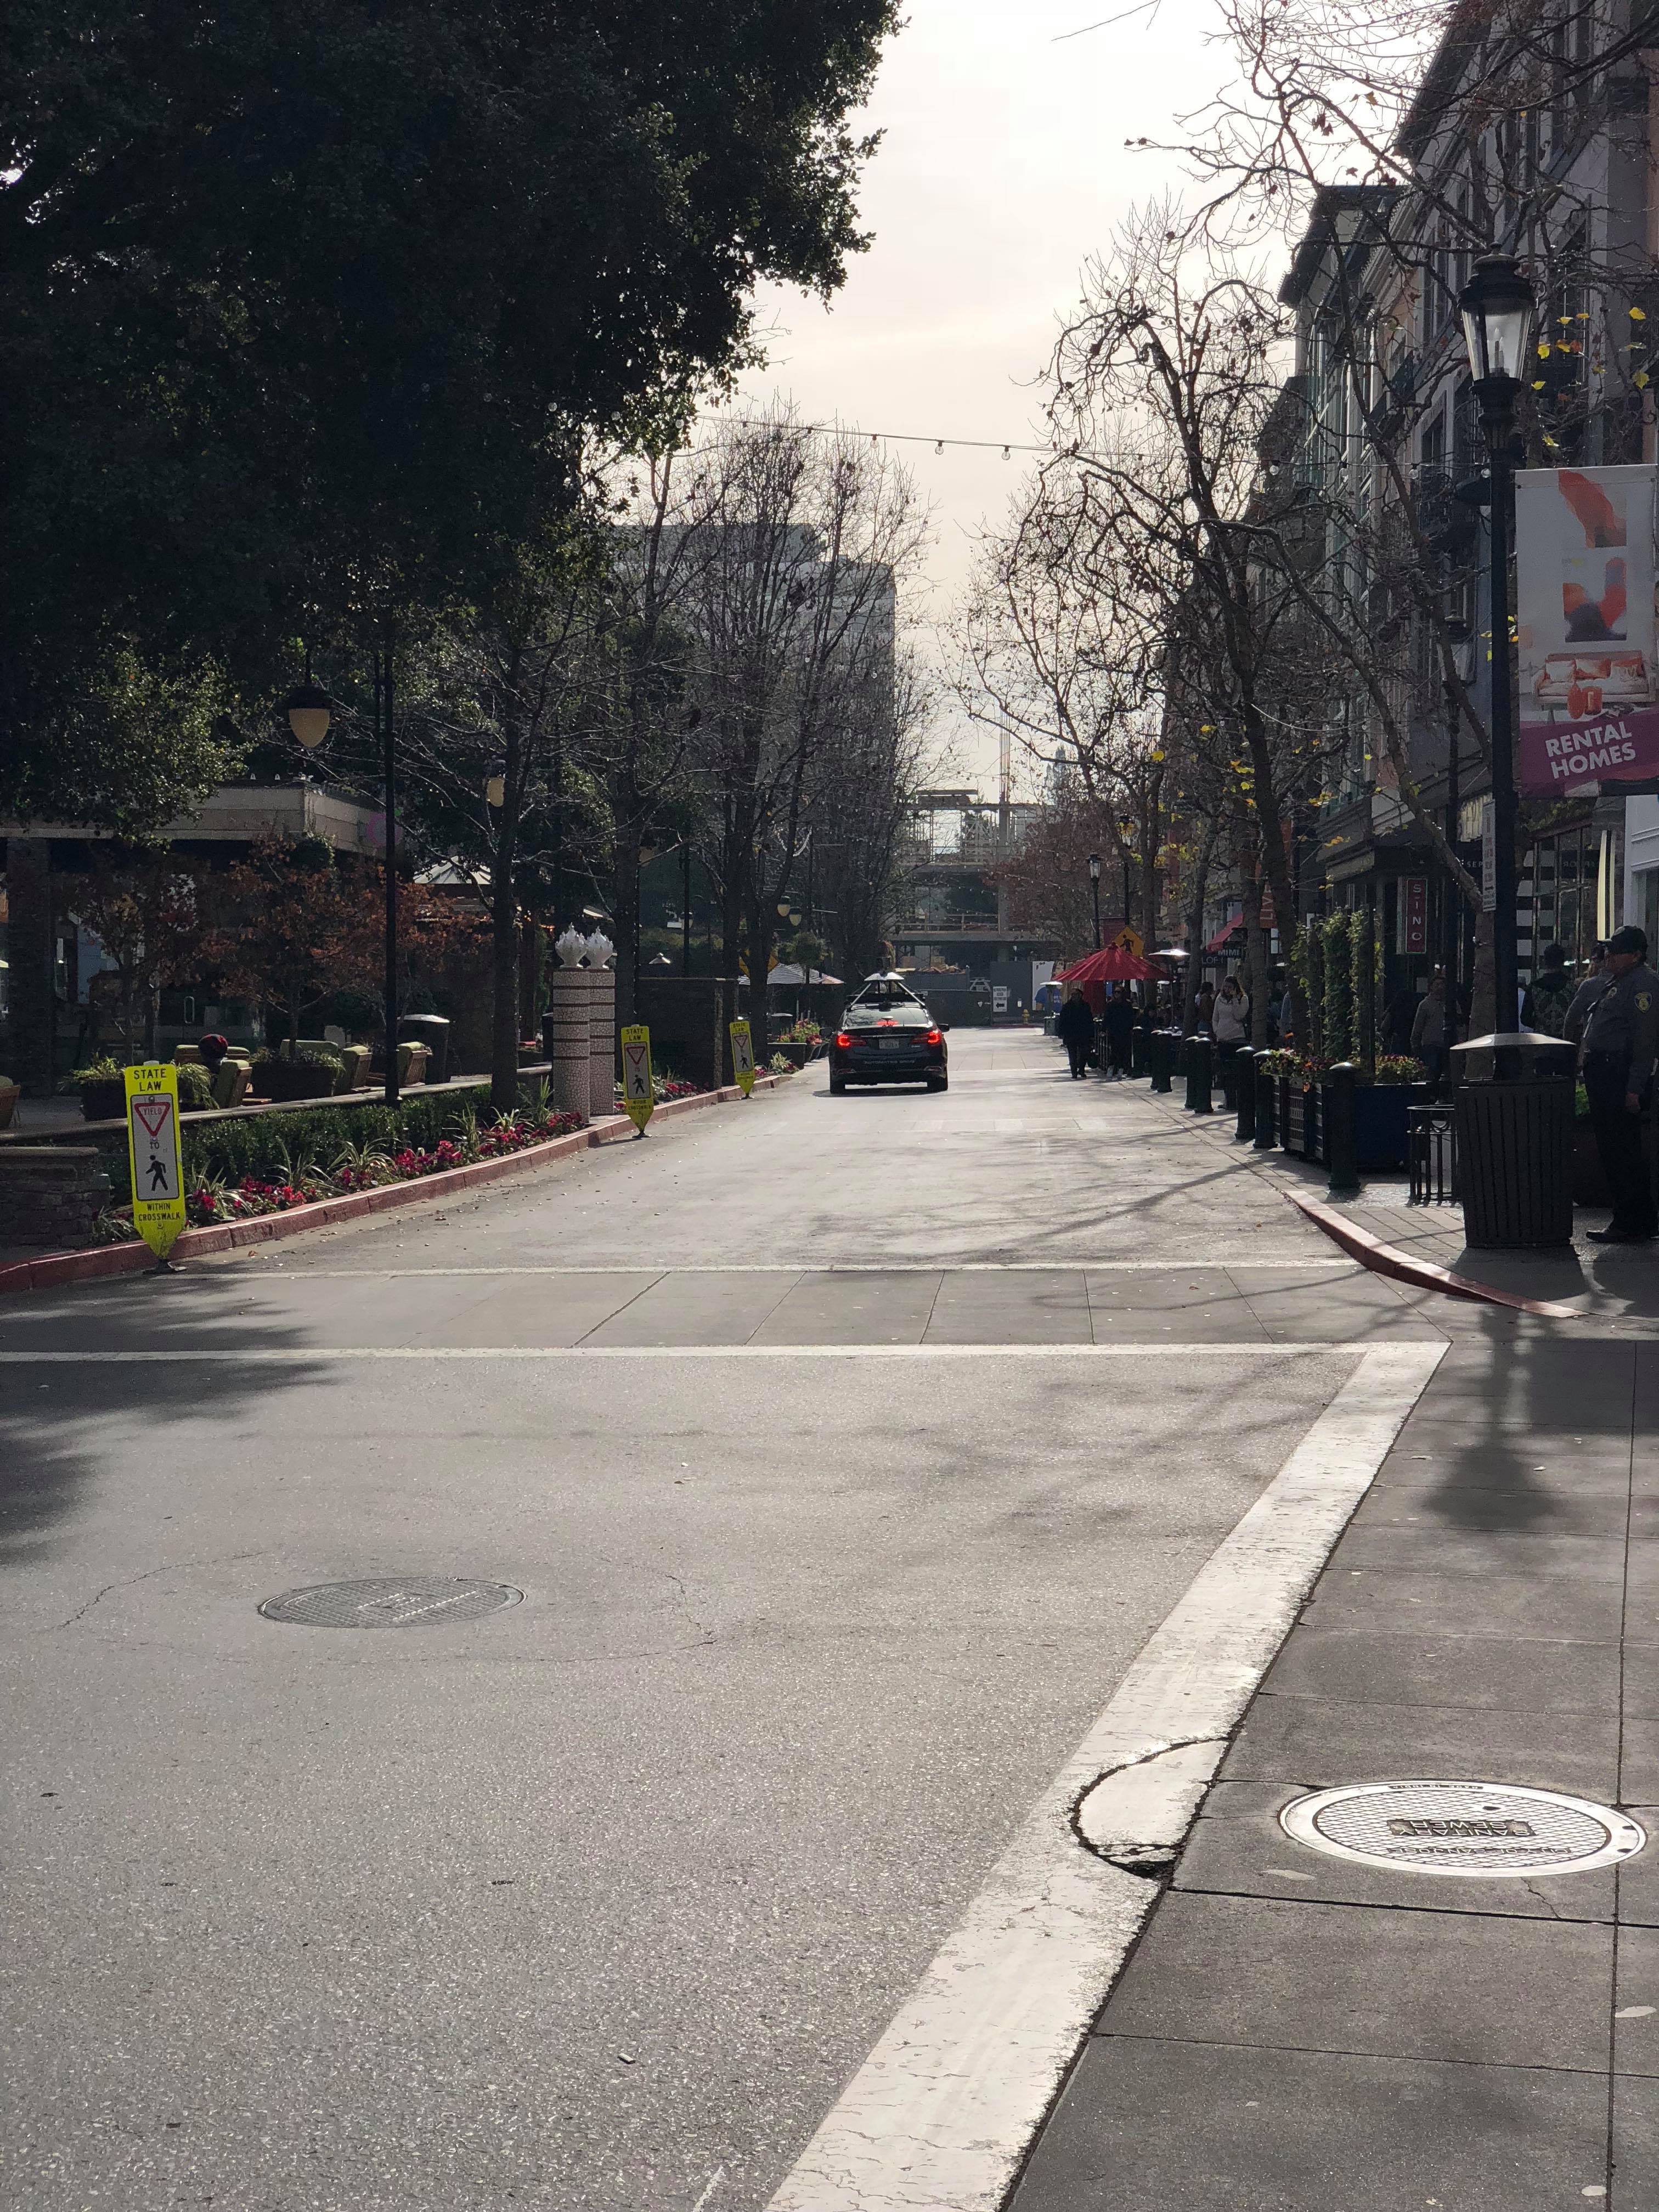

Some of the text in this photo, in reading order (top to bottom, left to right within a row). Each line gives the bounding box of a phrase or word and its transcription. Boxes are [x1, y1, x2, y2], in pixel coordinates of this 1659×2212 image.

[1545, 721, 1633, 758] RENTAL
[1550, 742, 1637, 779] HOMES
[1411, 884, 1422, 941] SINO
[133, 1068, 167, 1080] STATE
[139, 1082, 162, 1091] LAW
[143, 1107, 162, 1116] YIELD
[146, 1202, 171, 1211] WITHIN
[138, 1211, 180, 1222] CROSSWALK
